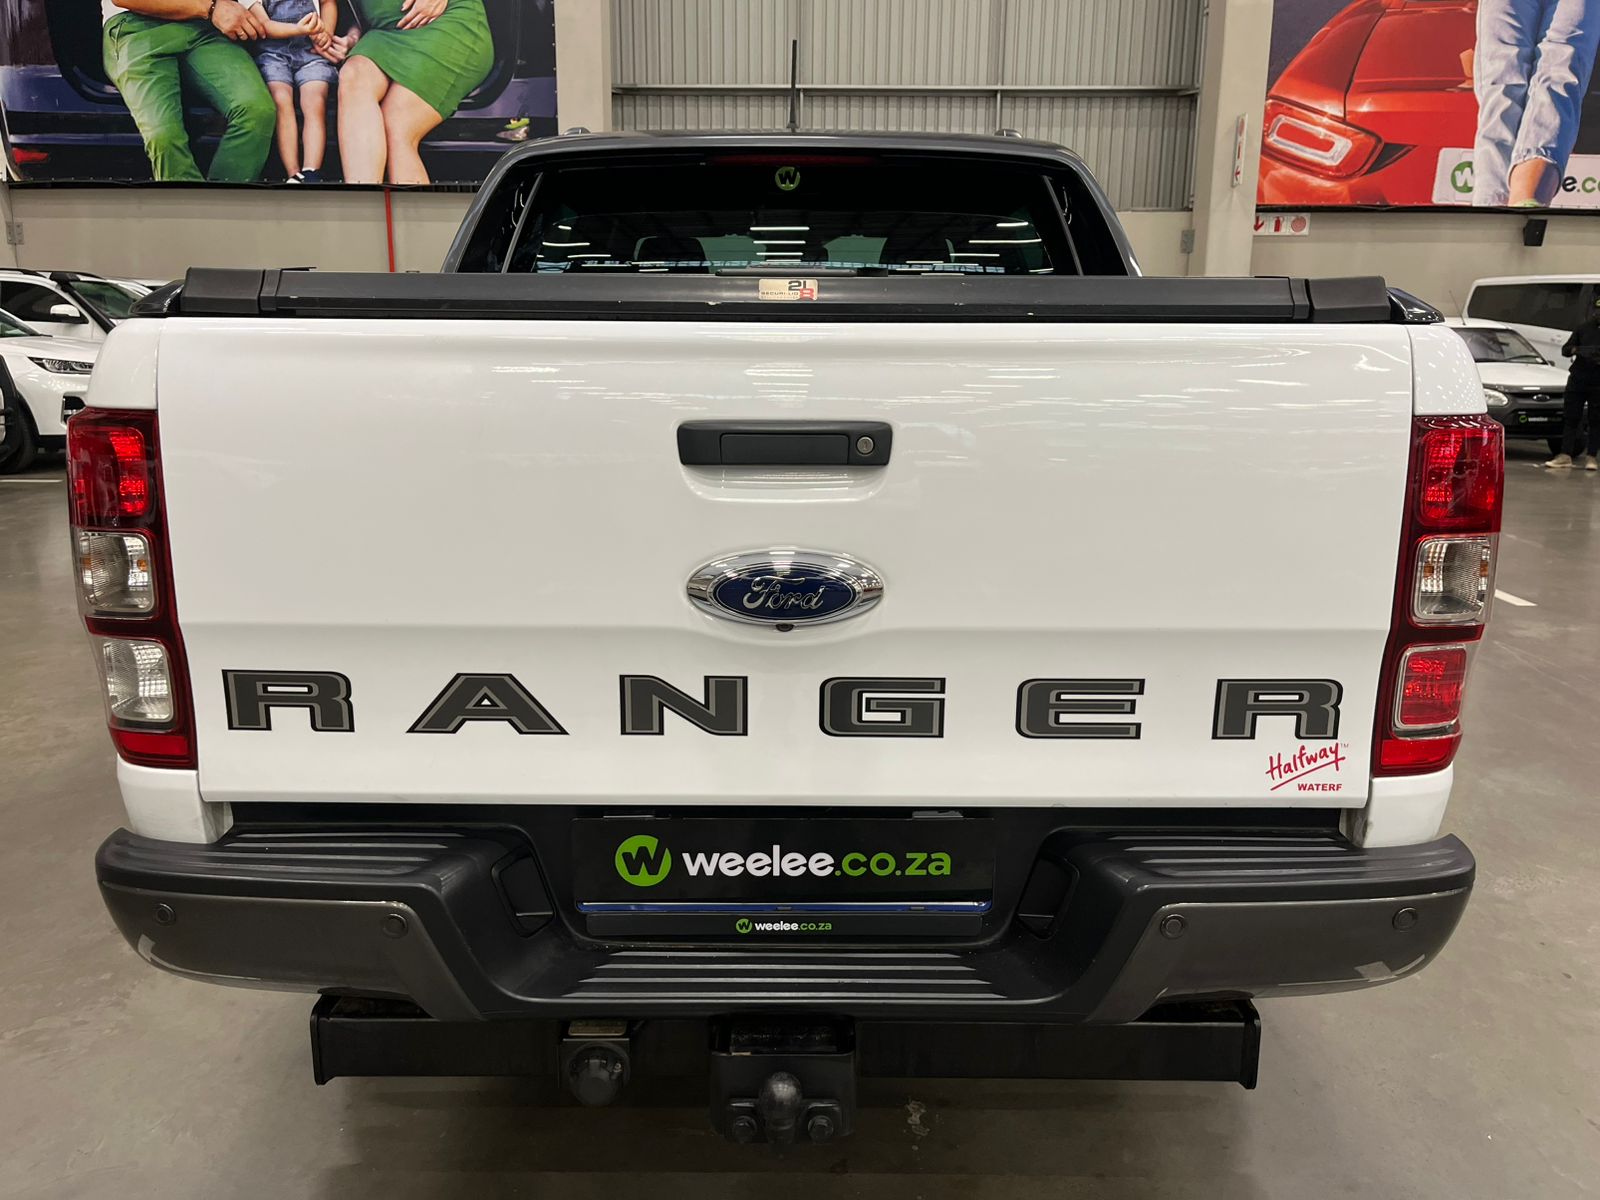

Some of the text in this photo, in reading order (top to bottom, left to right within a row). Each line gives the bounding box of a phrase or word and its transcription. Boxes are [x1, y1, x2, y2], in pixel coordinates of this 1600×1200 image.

[743, 576, 826, 609] Ford
[222, 669, 1344, 740] RANGER
[1265, 742, 1340, 781] Halfway
[1297, 783, 1342, 791] WATERF
[682, 845, 951, 877] weelee.co.za
[754, 921, 833, 931] weelee.co.za
